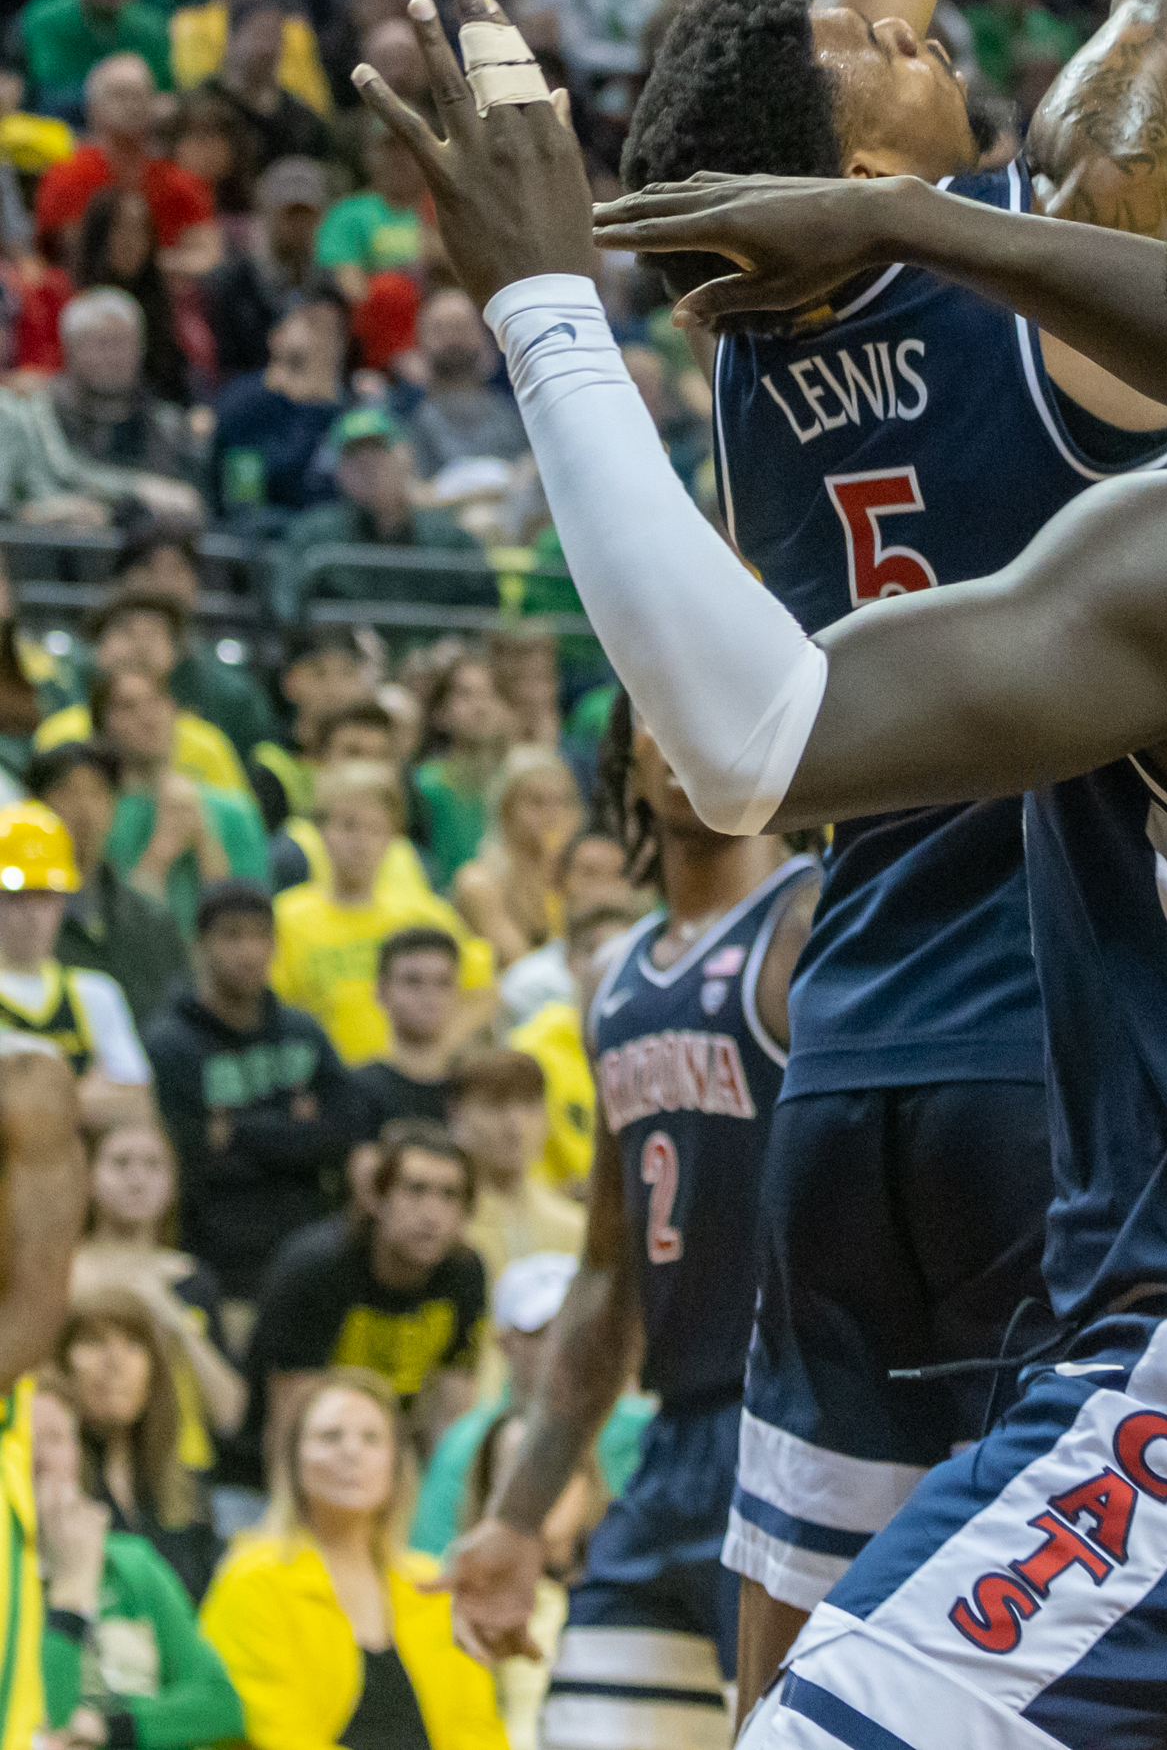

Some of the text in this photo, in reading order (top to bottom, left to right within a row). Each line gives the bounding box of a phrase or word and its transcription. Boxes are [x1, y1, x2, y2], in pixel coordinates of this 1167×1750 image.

[761, 339, 928, 445] LEWIS
[824, 465, 938, 609] 5
[641, 1130, 684, 1265] 2
